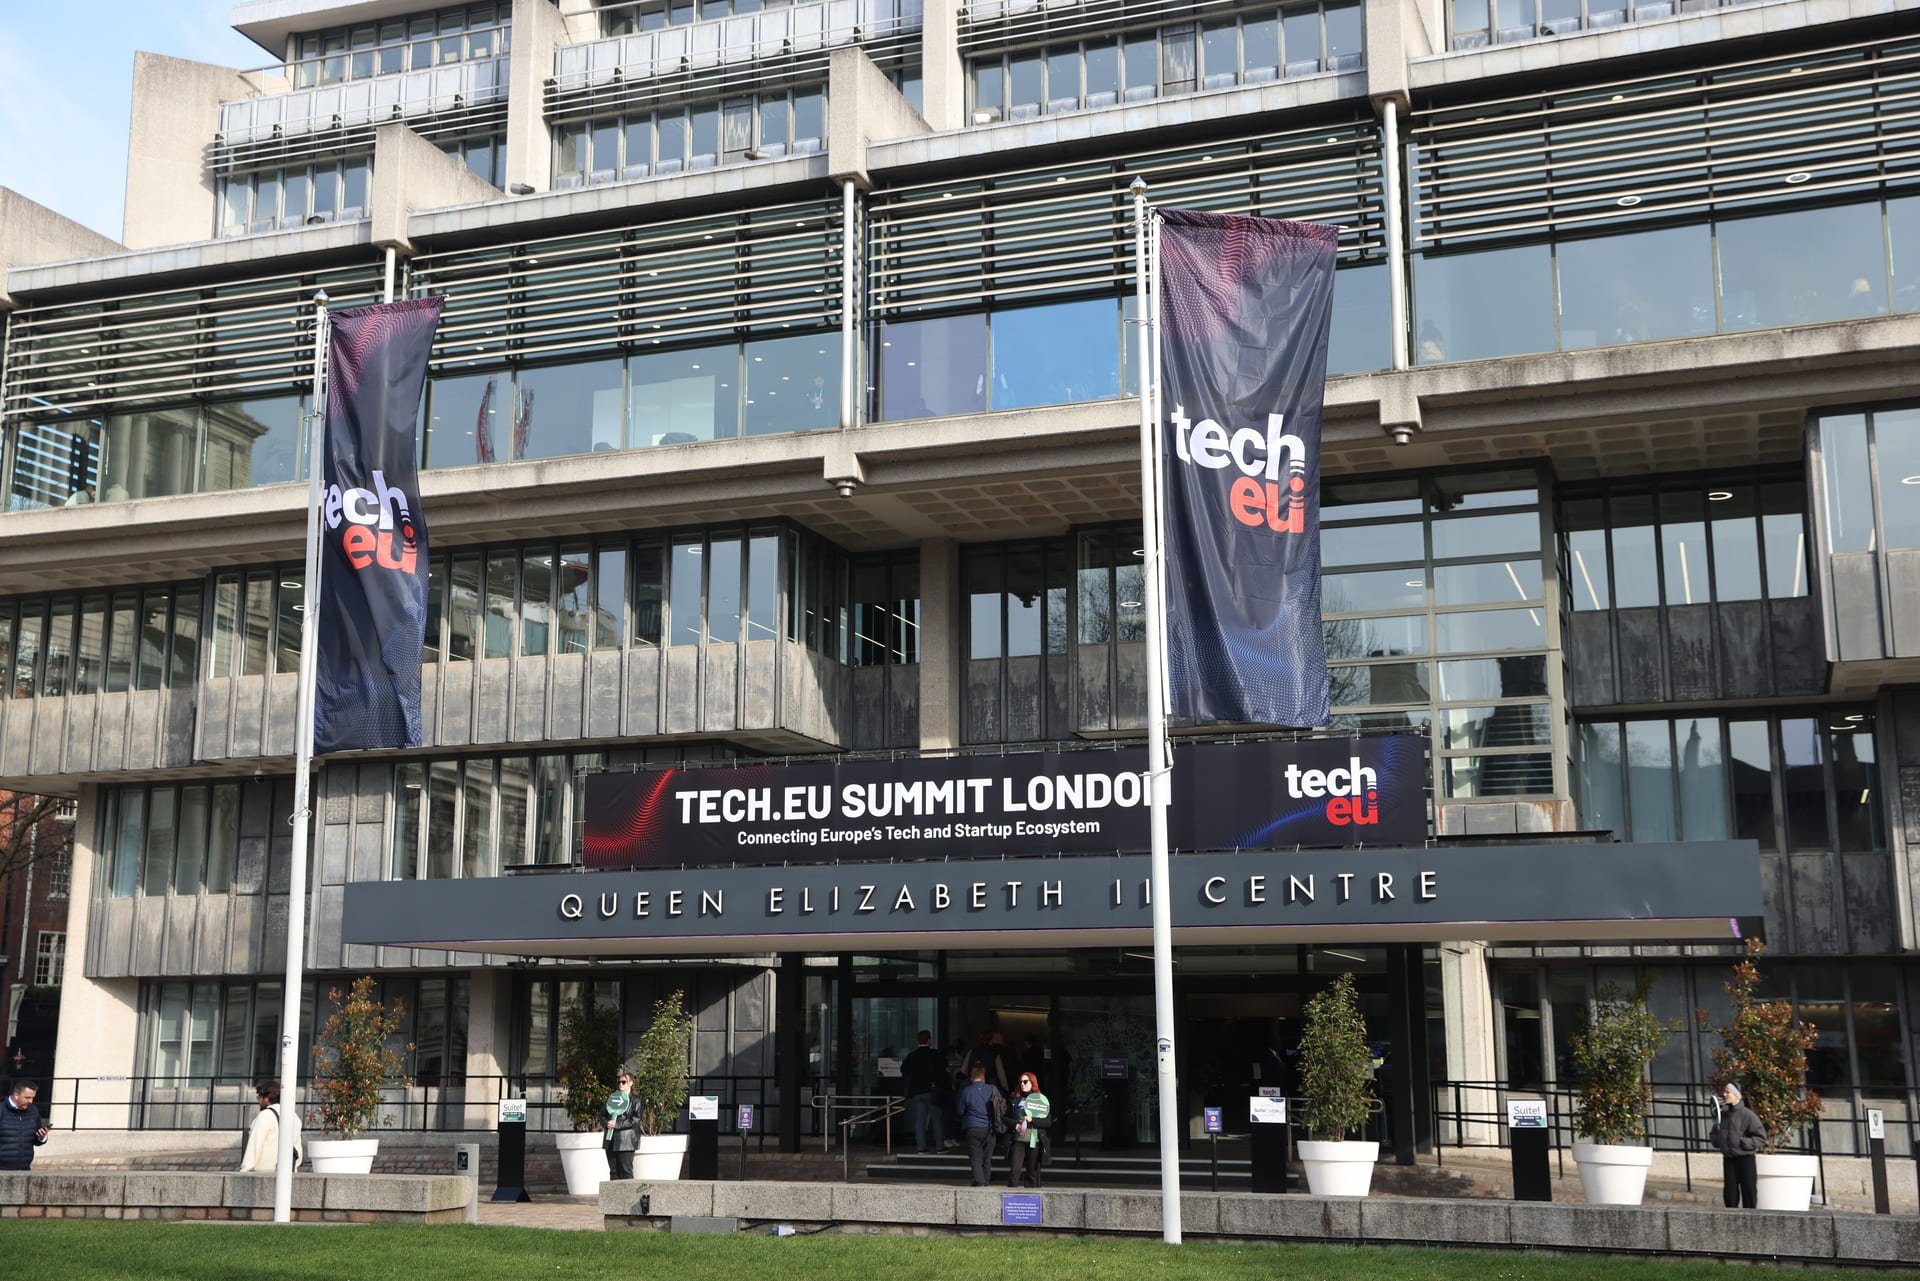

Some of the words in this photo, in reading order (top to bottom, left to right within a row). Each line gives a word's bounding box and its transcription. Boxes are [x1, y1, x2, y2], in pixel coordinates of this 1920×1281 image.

[1171, 403, 1305, 481] tech
[323, 470, 411, 532] ech
[1230, 476, 1305, 533] eu
[343, 525, 417, 575] eu
[675, 784, 831, 824] TECH.EU
[841, 778, 993, 818] SUMMIT
[1285, 757, 1377, 798] tech
[1326, 791, 1378, 826] eu
[737, 829, 818, 846] Connecting
[820, 826, 883, 844] Europe's
[885, 825, 921, 840] Tech
[924, 824, 951, 838] and
[955, 823, 1012, 840] Startup
[1016, 820, 1100, 838] Ecosystem
[560, 889, 723, 919] QUEEN
[770, 880, 1063, 912] ELIZABETH
[1115, 878, 1150, 904] II
[1204, 871, 1437, 904] CENTRE
[1513, 1105, 1540, 1115] Suite!
